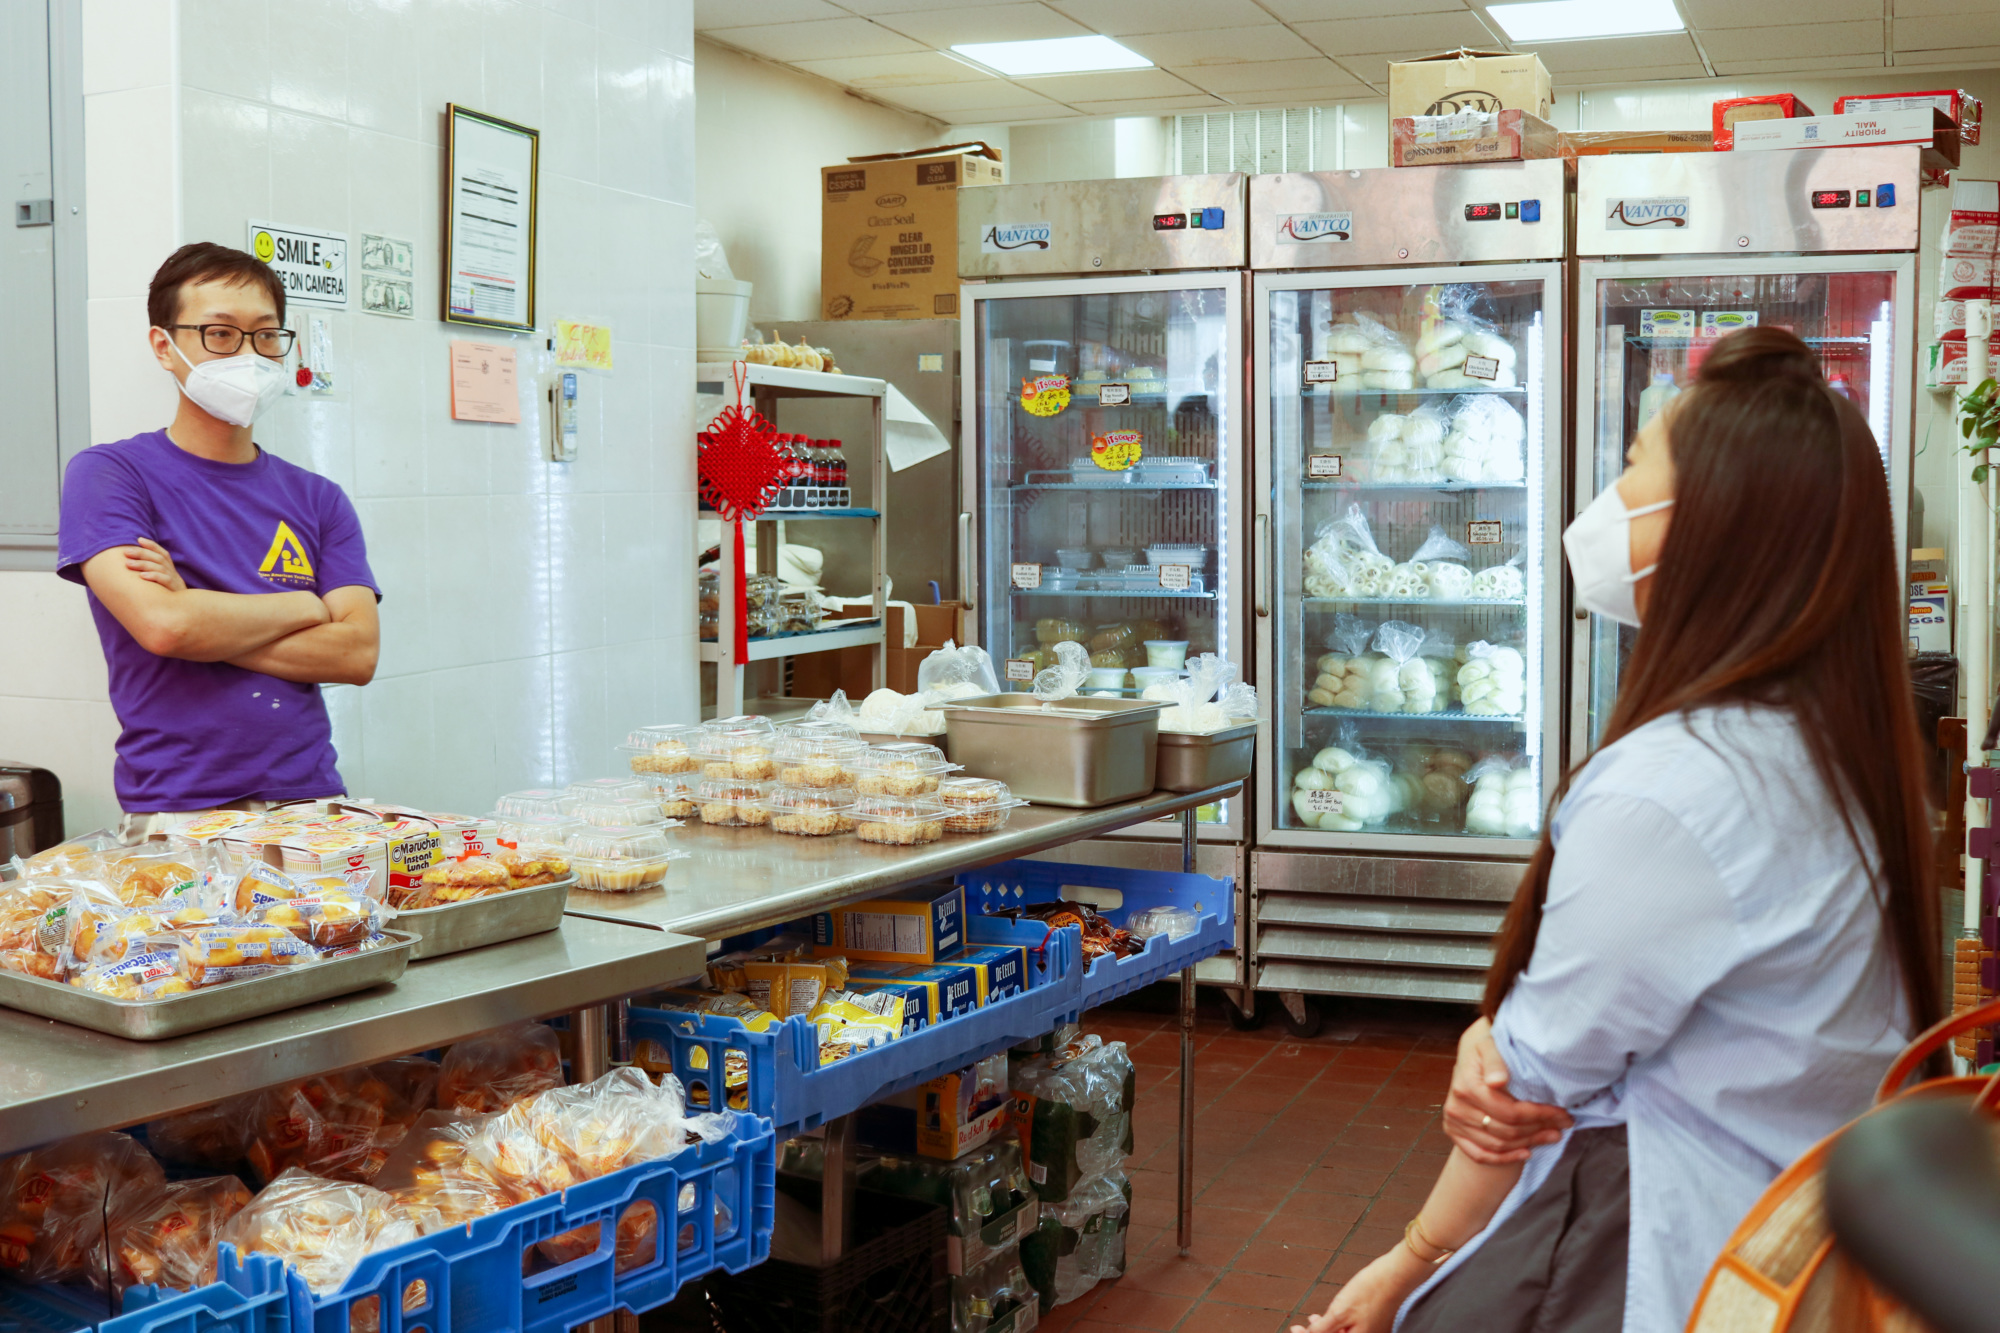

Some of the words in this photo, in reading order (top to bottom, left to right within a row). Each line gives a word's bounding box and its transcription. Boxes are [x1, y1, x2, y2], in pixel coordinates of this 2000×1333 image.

[1844, 128, 1886, 137] PRIORITY
[1412, 146, 1456, 156] Maruchan
[1474, 142, 1499, 152] Beef
[929, 165, 944, 174] 500
[927, 175, 946, 183] CLEAR
[1608, 201, 1687, 222] AVANTCO
[1278, 216, 1350, 236] AVANTCO
[899, 232, 923, 243] CLEAR
[984, 226, 1049, 245] AVANTCO
[277, 237, 321, 266] SMILE
[890, 244, 918, 256] HINGED
[919, 243, 932, 254] LID
[888, 255, 935, 268] CONTAINERS
[289, 272, 303, 291] ON
[305, 274, 345, 296] CAMERA
[569, 324, 599, 345] CPR
[401, 837, 441, 854] Maruchan
[404, 851, 432, 865] Instant
[407, 860, 430, 873] Lunch
[410, 878, 423, 887] Bee
